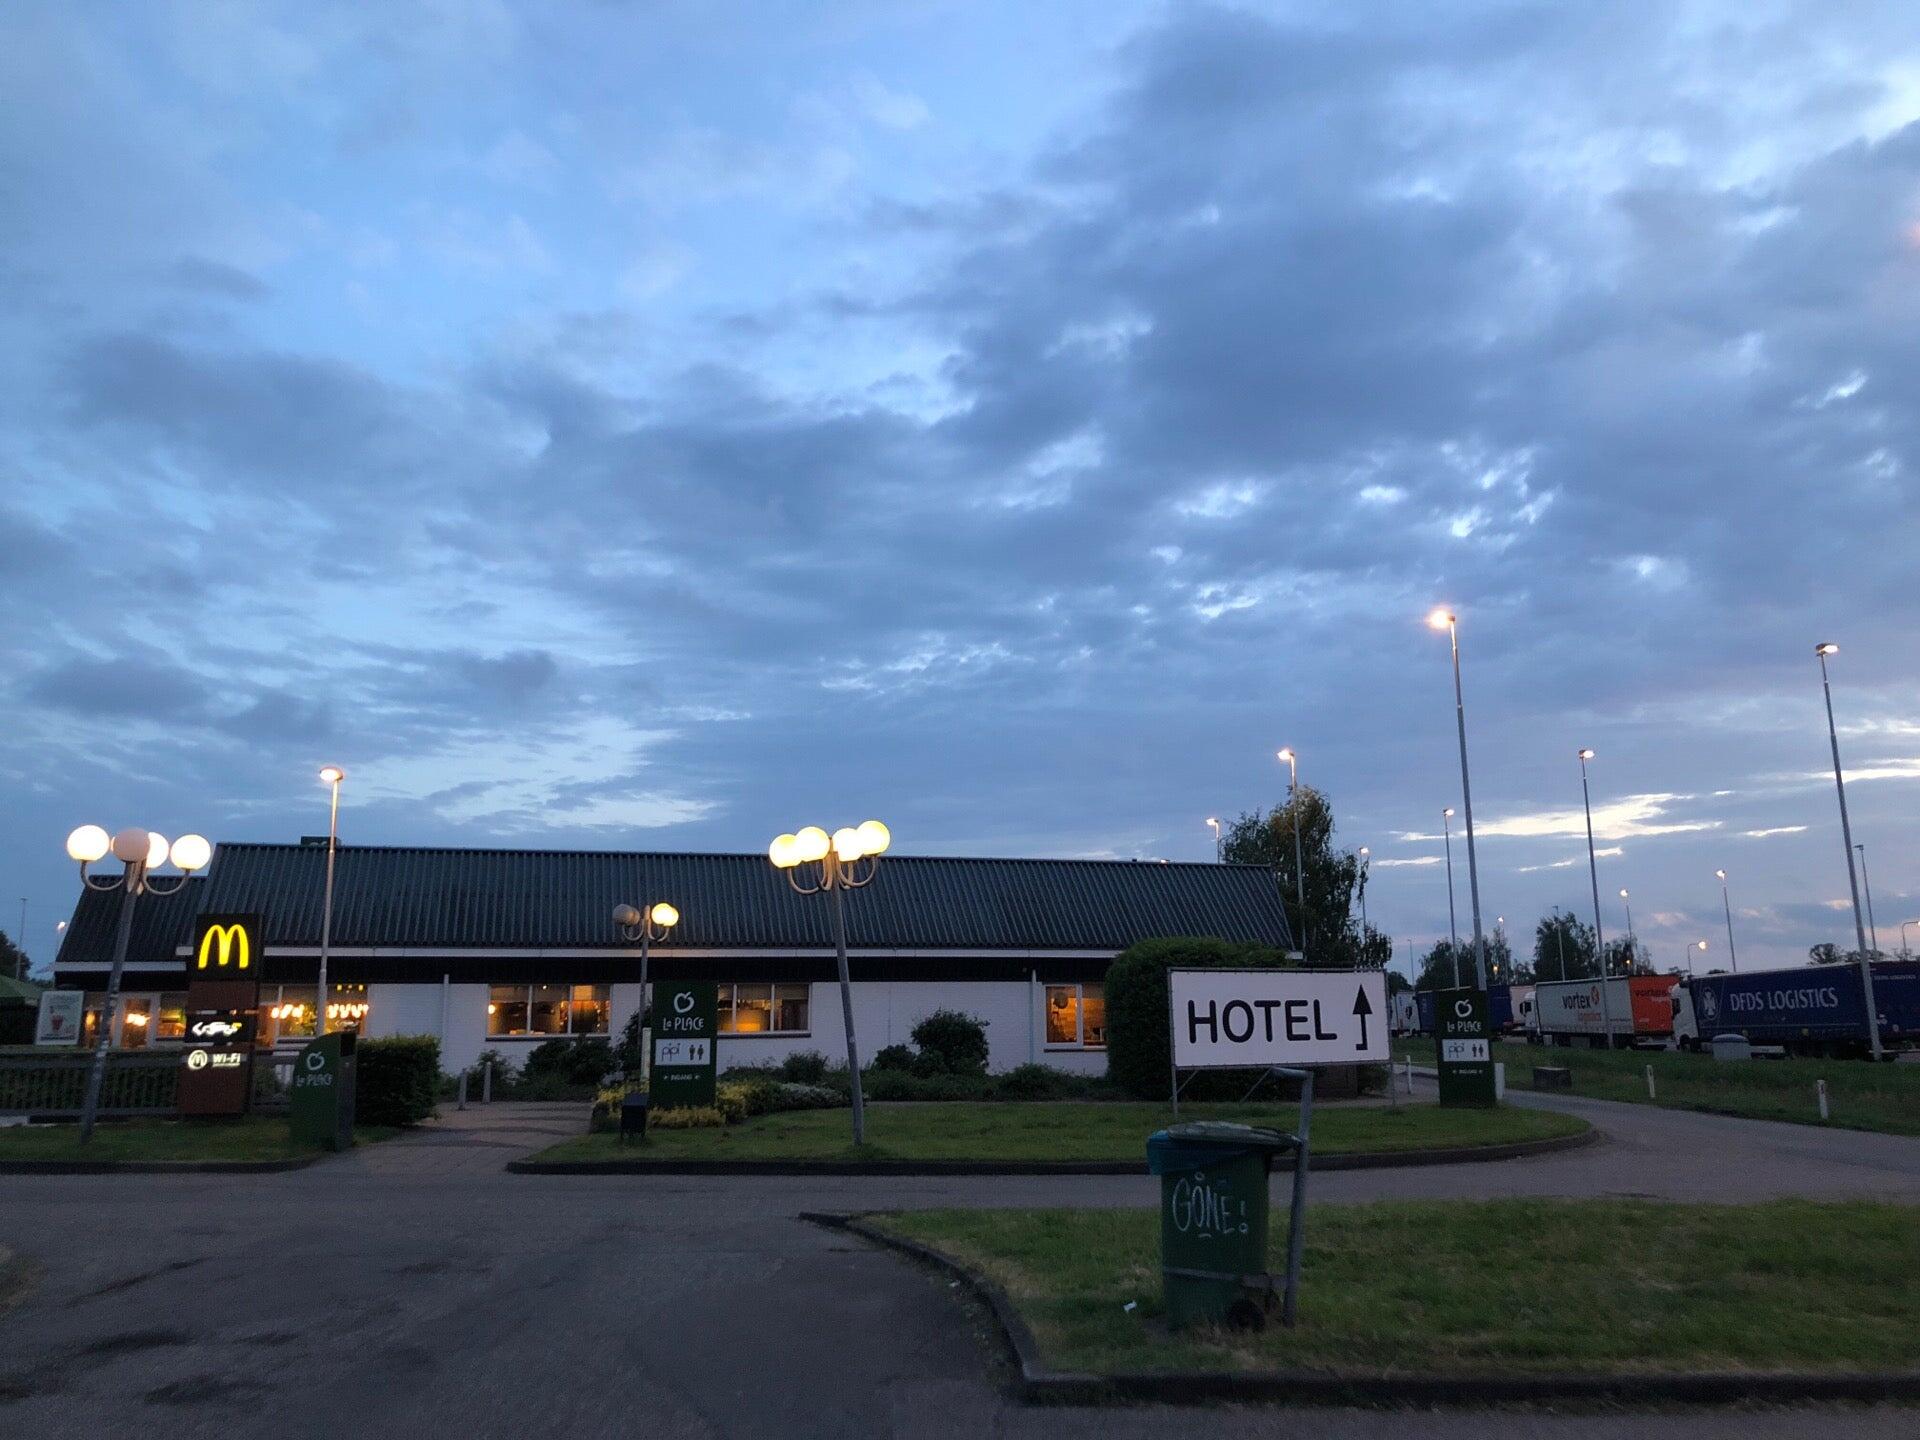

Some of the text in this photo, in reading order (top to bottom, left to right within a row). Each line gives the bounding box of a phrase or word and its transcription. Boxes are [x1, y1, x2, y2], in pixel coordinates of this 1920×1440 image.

[1562, 992, 1591, 1009] vortex
[1730, 987, 1838, 1011] DFDS LOGISTICS
[675, 1017, 705, 1030] PLACE
[1188, 1000, 1337, 1043] HOTEL
[1457, 1021, 1481, 1032] PLACE
[212, 1053, 241, 1066] Wi-Fi
